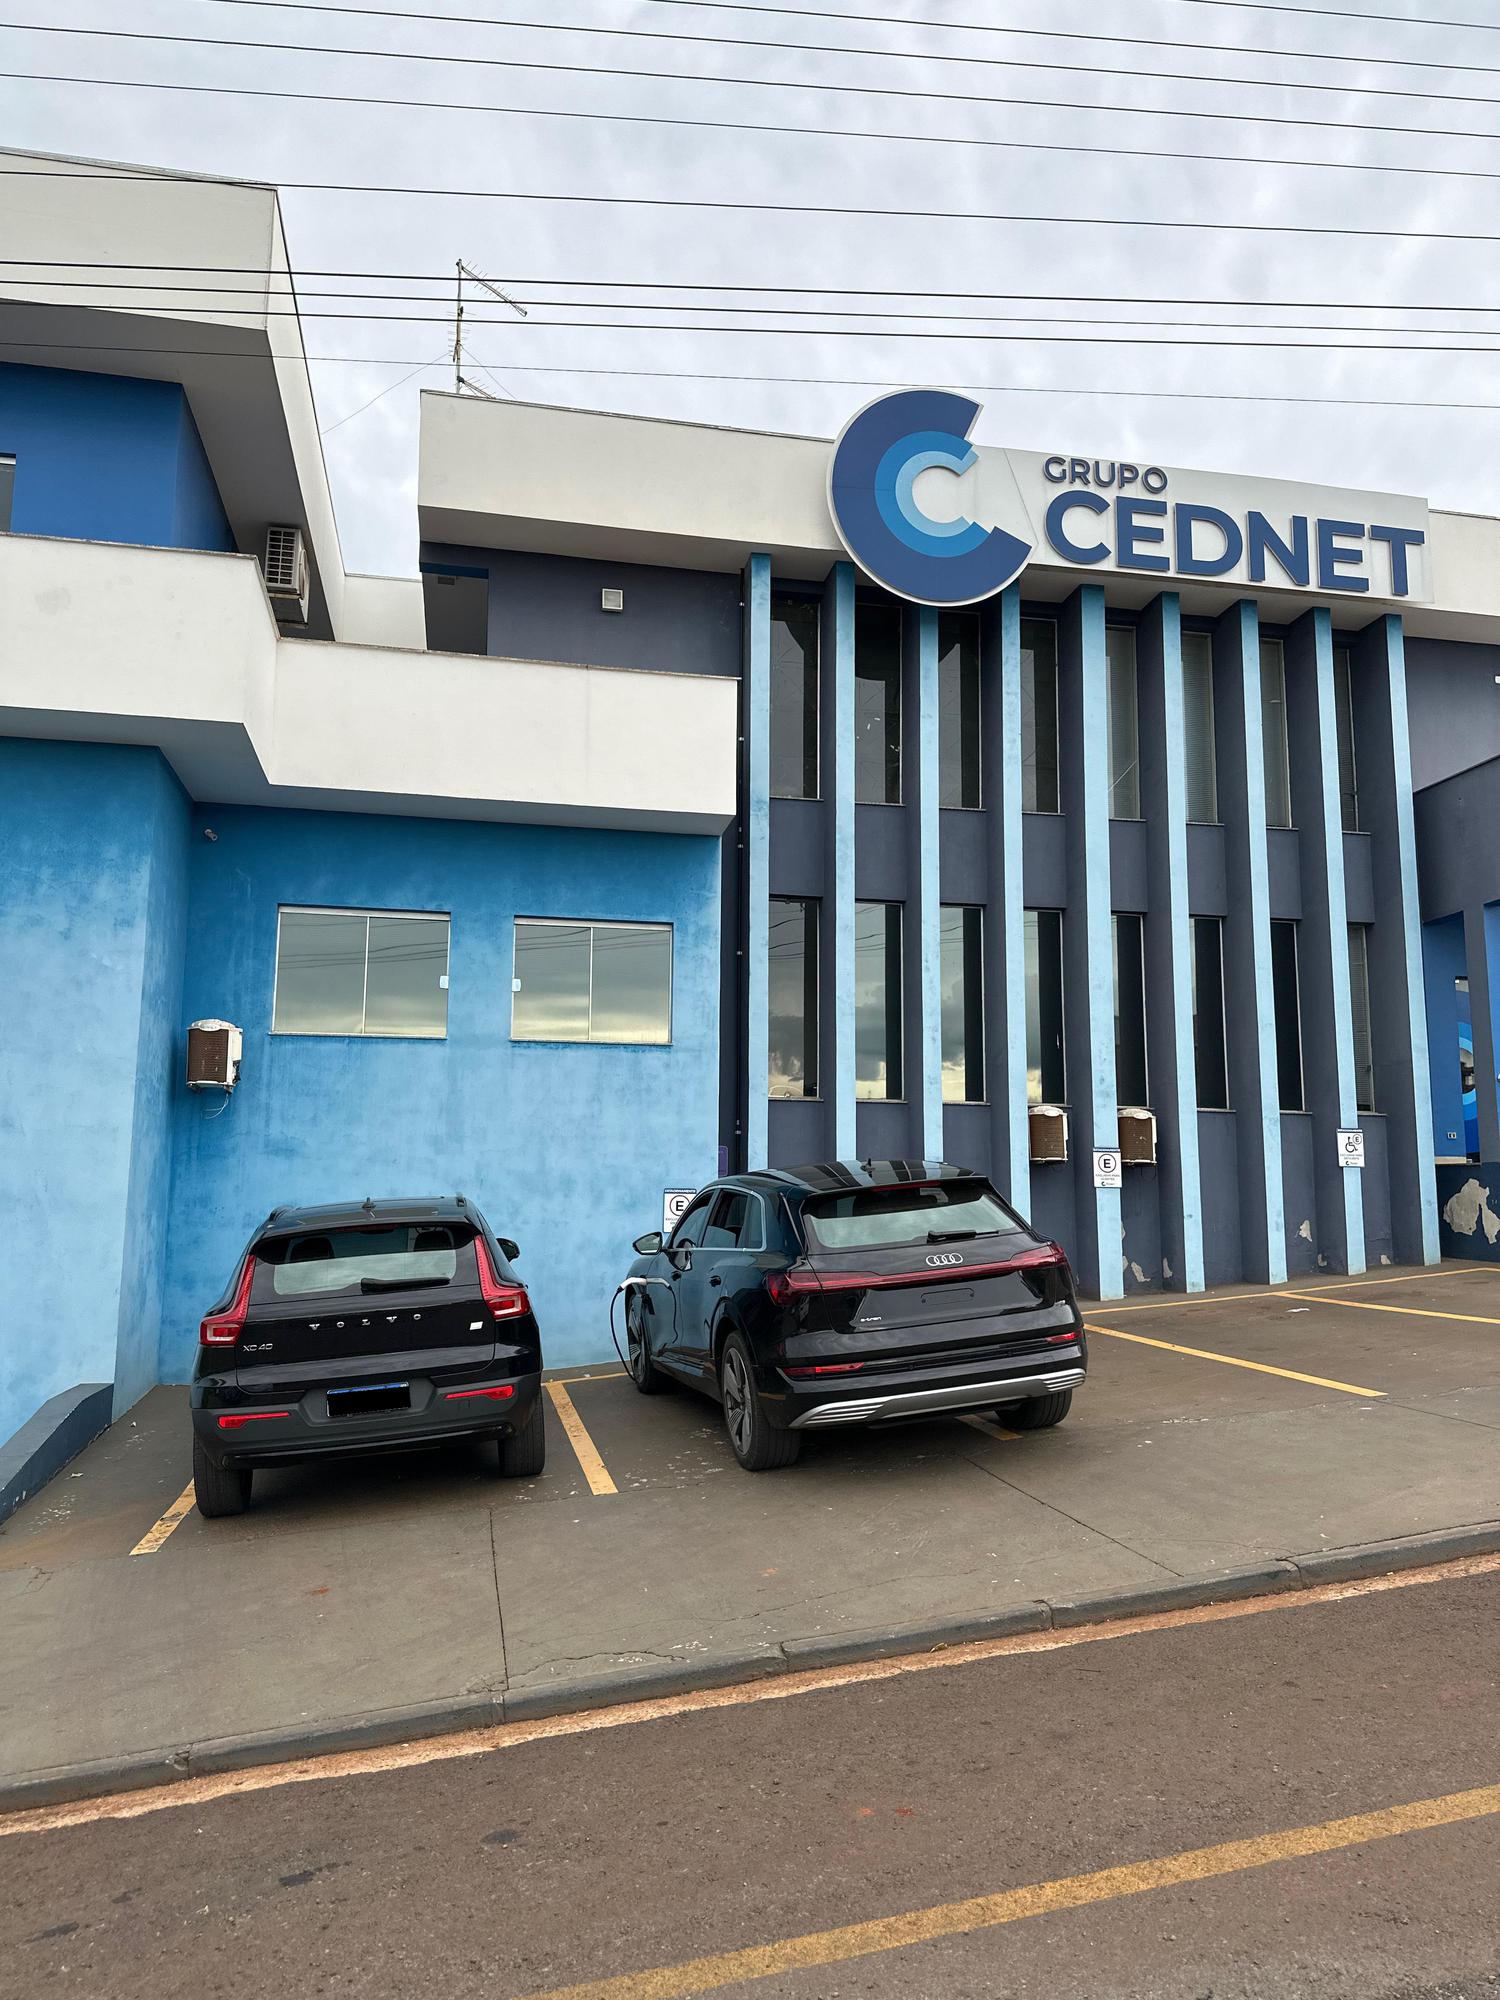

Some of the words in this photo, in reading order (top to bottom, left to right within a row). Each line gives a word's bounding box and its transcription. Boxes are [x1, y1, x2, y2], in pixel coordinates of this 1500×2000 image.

[1044, 456, 1168, 494] GRUPO
[1045, 490, 1425, 597] CEDNET
[1104, 1158, 1111, 1168] E
[676, 1200, 684, 1212] E
[309, 1314, 421, 1330] VOLVO
